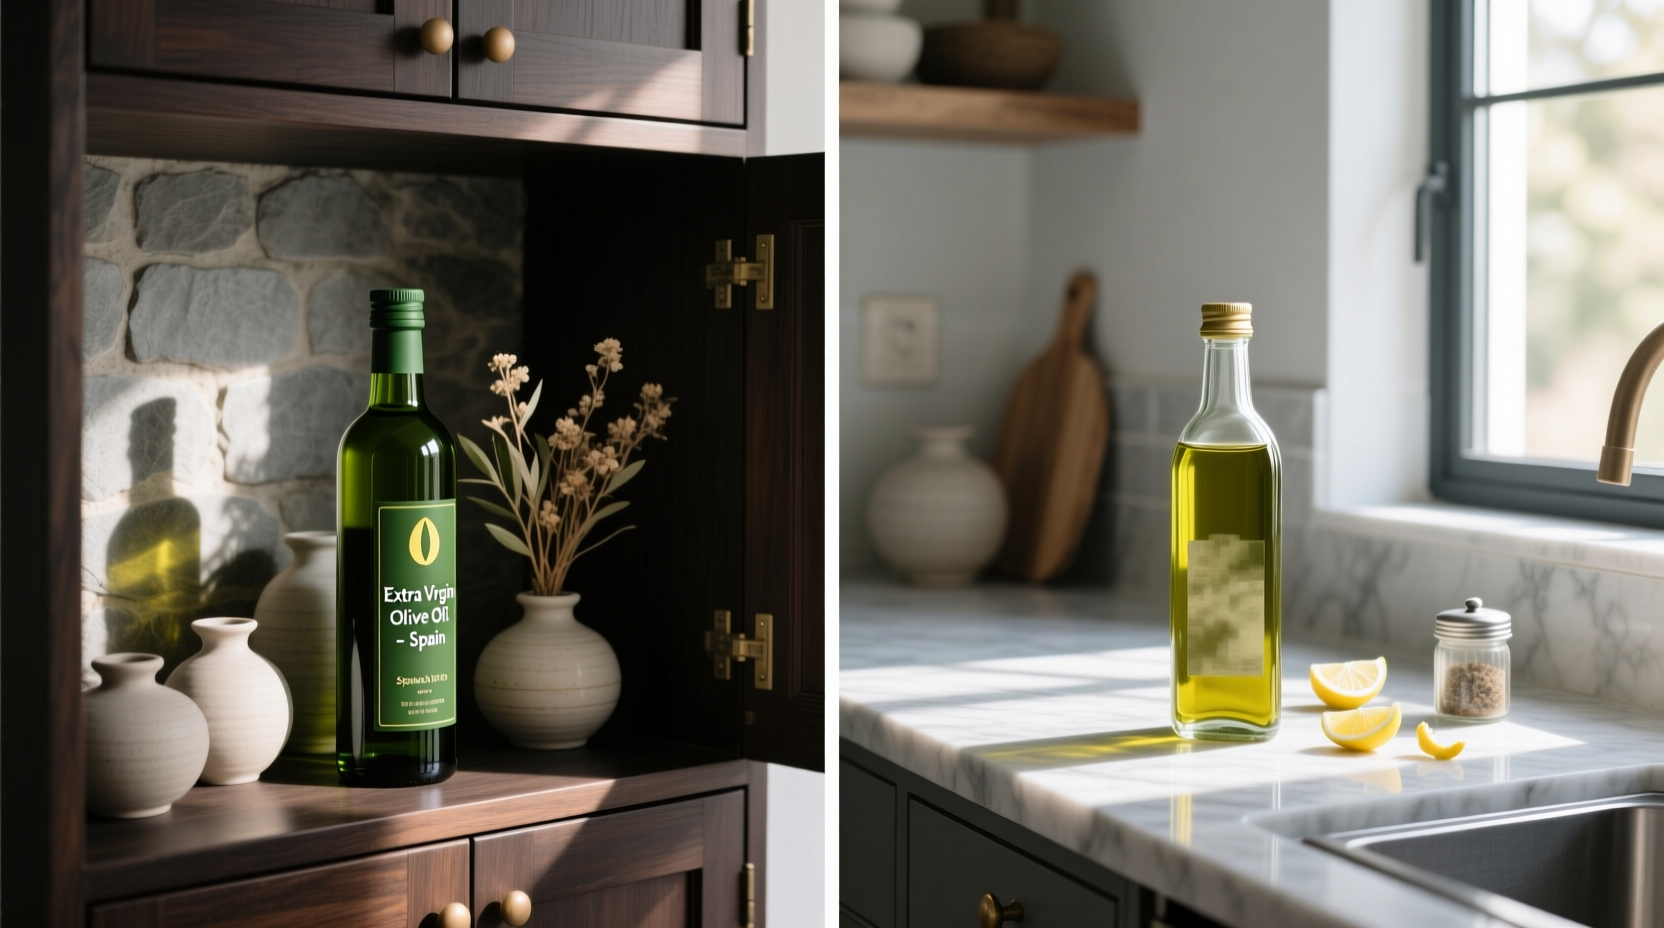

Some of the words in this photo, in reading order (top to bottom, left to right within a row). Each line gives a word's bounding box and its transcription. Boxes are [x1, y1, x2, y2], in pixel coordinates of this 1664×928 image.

[384, 586, 422, 602] Extra
[390, 609, 429, 626] Olive
[410, 630, 446, 652] Spain
